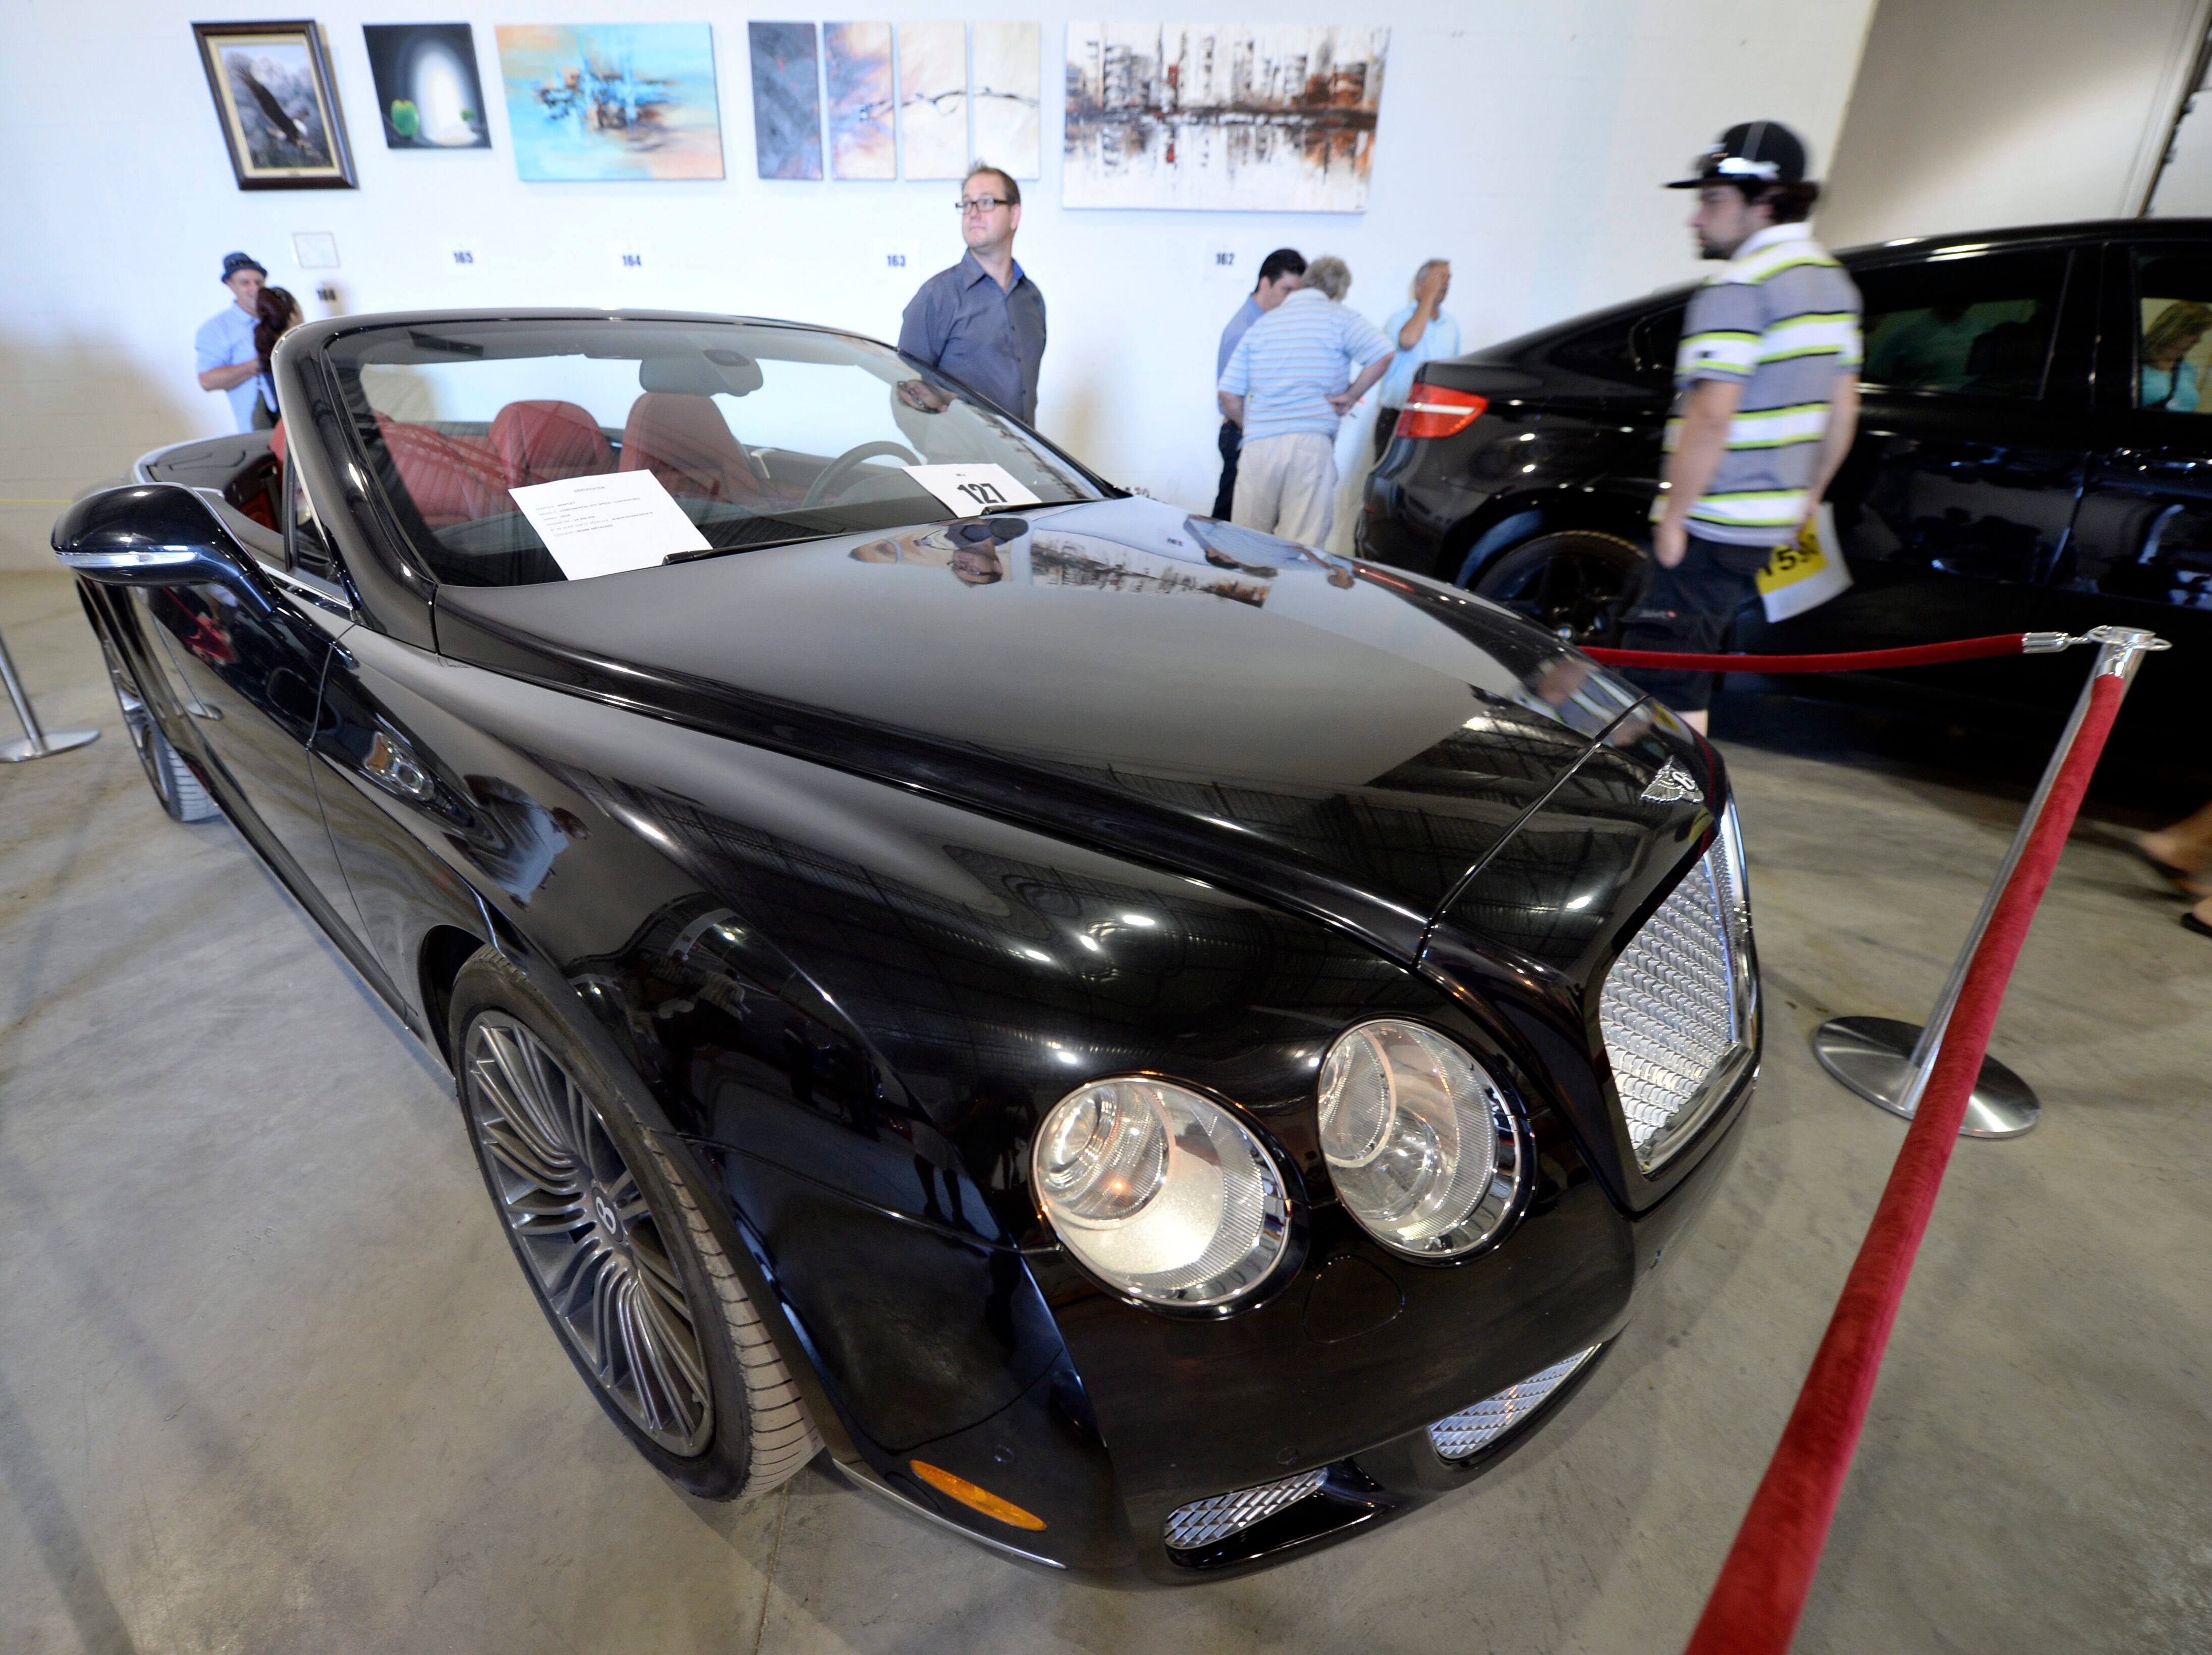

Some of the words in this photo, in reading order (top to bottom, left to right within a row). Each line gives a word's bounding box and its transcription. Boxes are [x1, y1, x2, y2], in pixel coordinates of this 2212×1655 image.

[623, 255, 642, 266] 164
[888, 255, 906, 267] 163
[1216, 252, 1235, 265] 162
[957, 482, 1008, 505] 127
